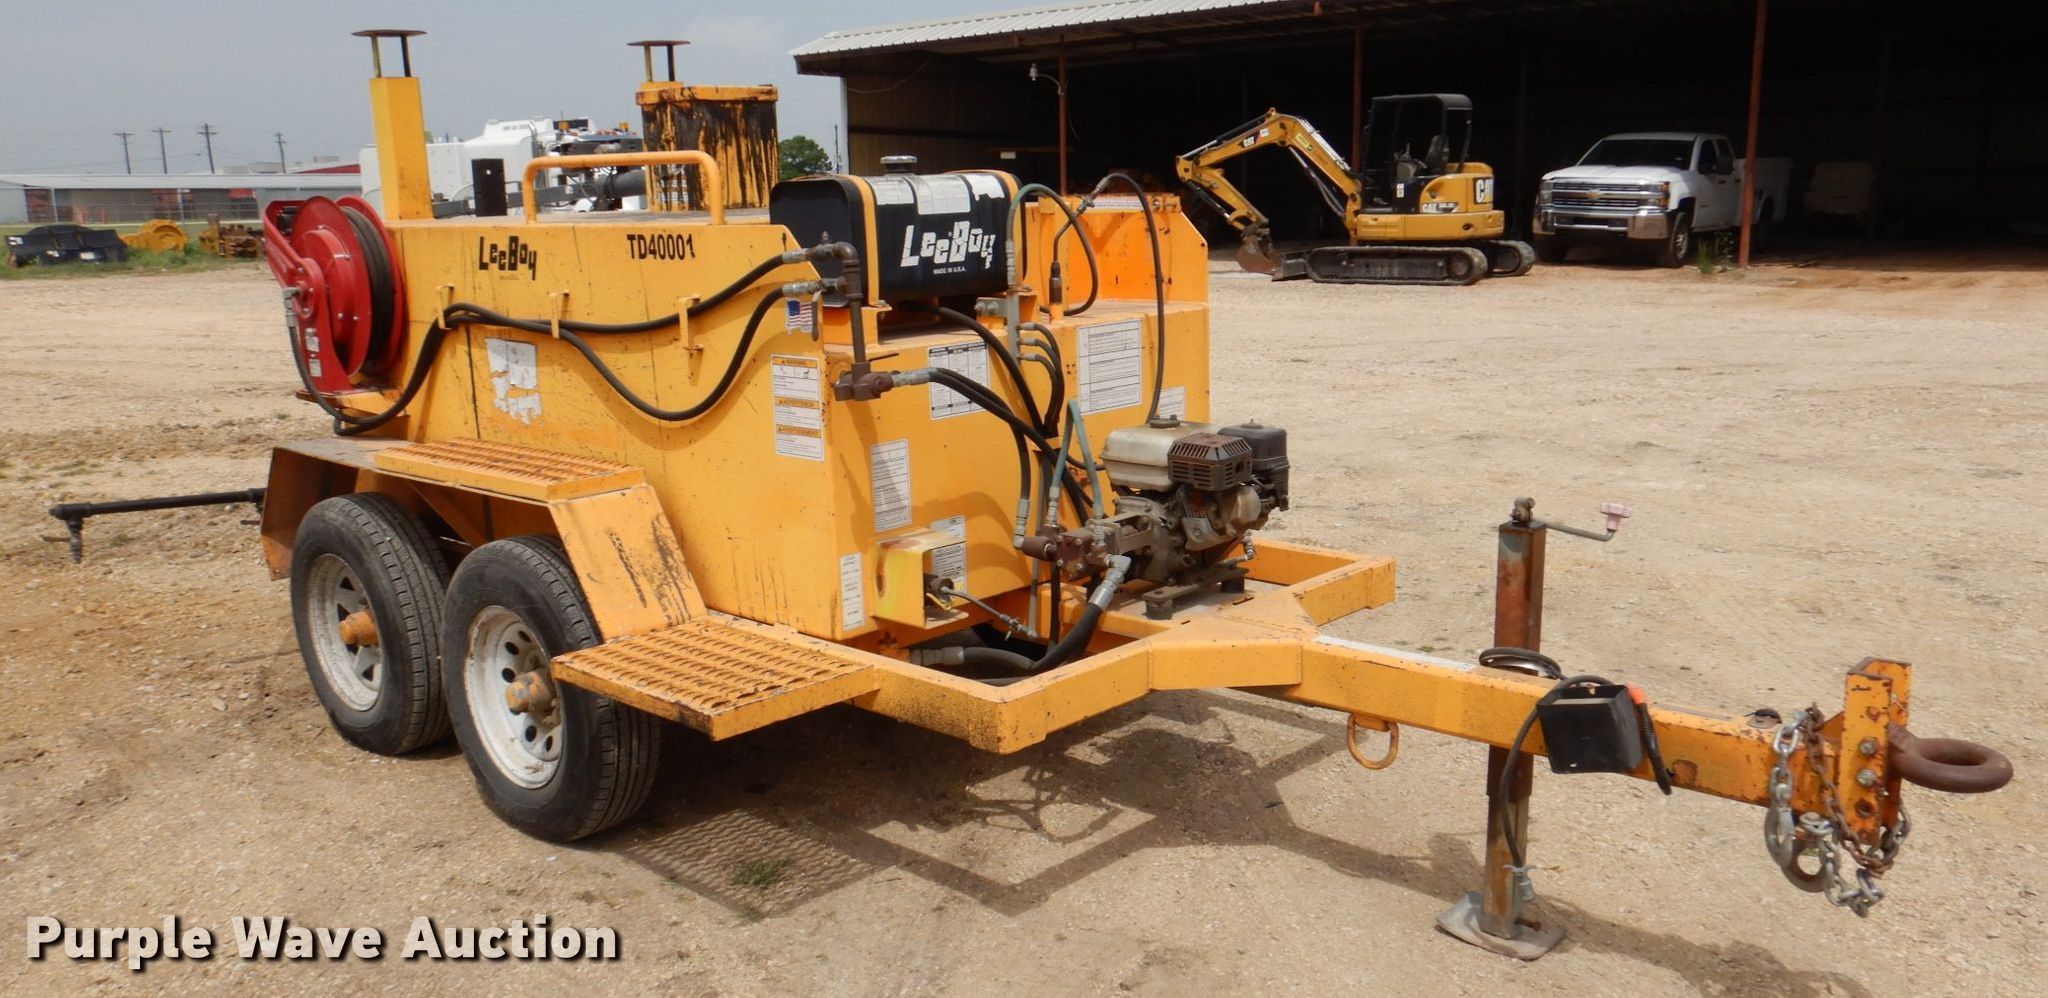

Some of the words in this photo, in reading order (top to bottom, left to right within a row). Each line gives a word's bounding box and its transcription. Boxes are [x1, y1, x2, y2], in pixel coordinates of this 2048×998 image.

[1243, 136, 1255, 147] CAT
[478, 235, 537, 281] LeeBoy
[627, 233, 696, 261] TD40001
[900, 220, 996, 270] LeeBoy
